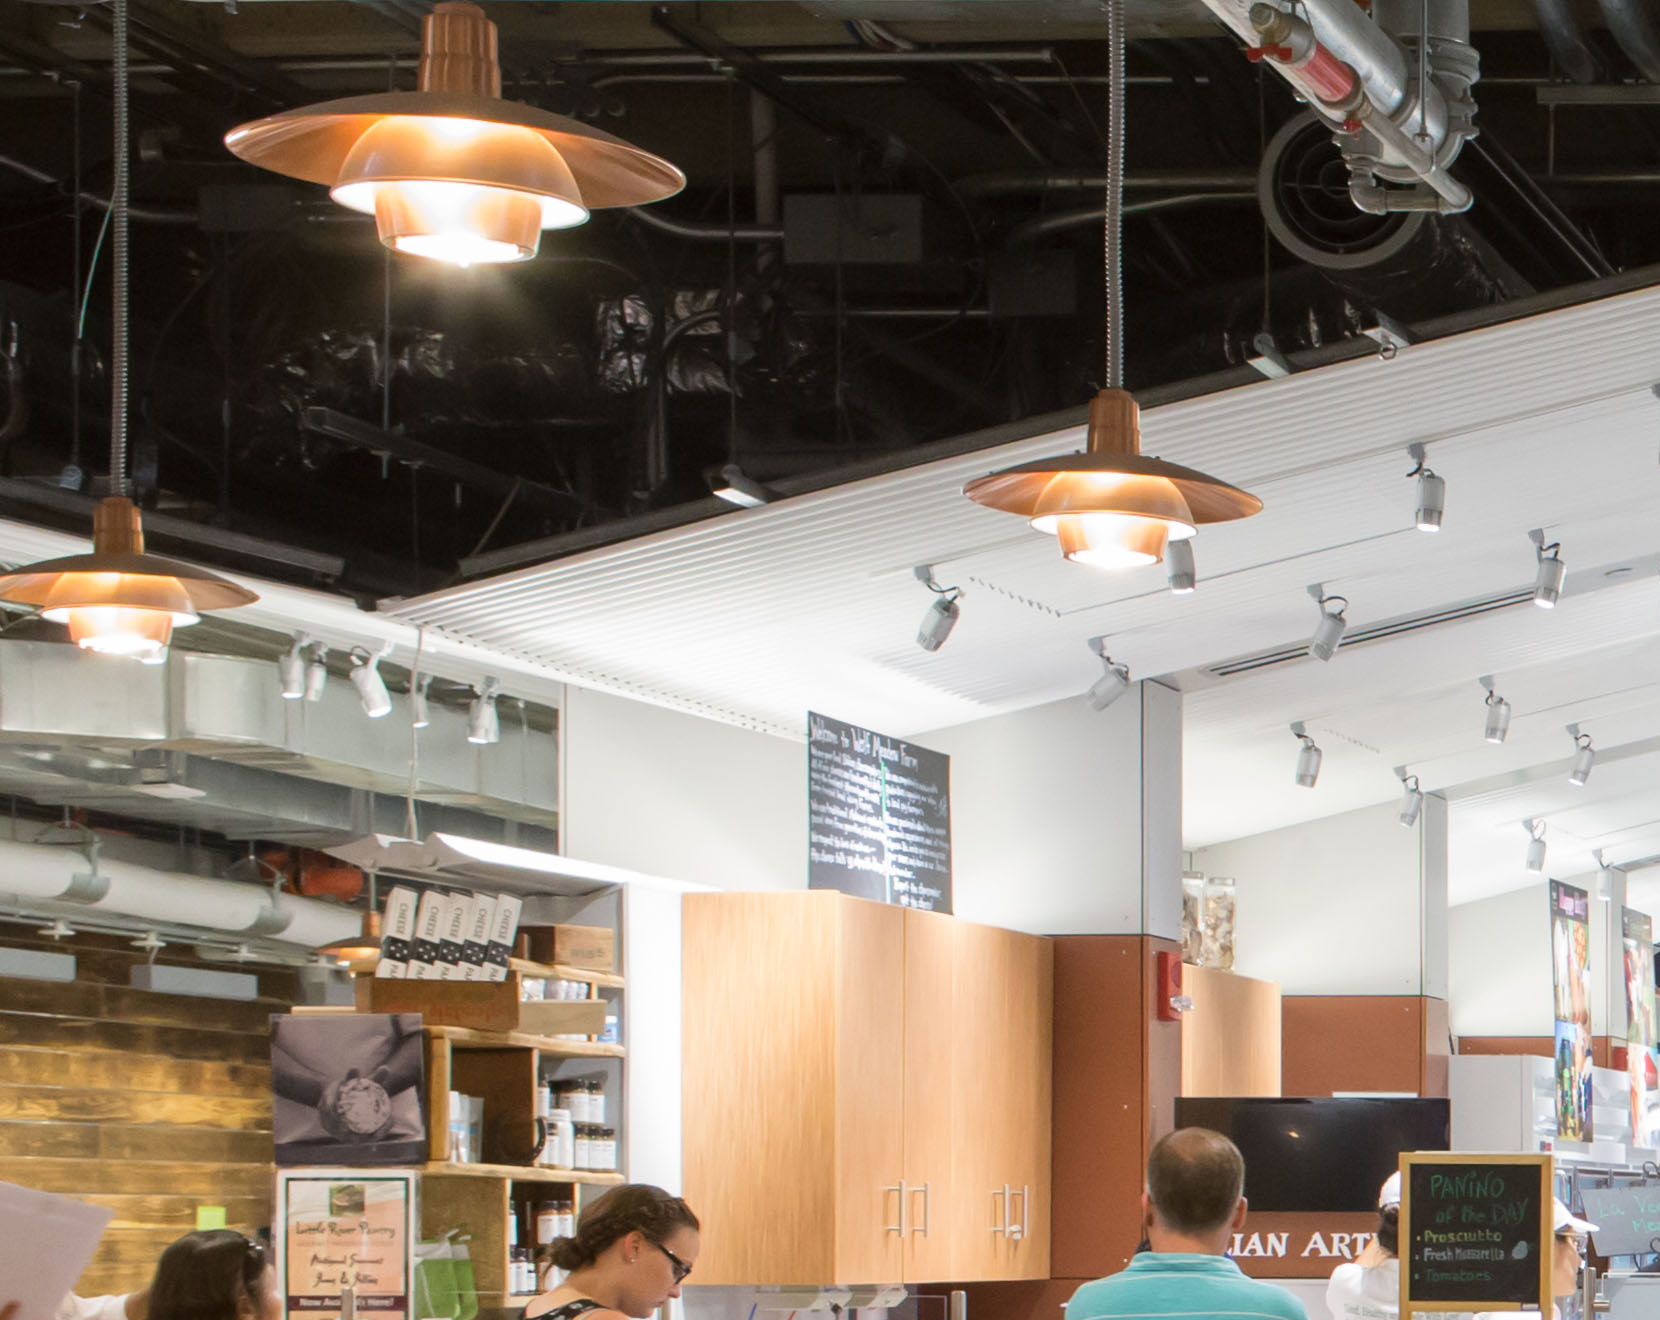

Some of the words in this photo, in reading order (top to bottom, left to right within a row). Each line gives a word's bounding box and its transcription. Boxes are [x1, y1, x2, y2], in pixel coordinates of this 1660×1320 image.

[396, 903, 409, 936] CHEESE
[426, 906, 439, 938] CHEESE
[450, 907, 463, 938] CHEESE
[474, 908, 487, 939] CHEESE
[498, 909, 512, 940] CHEESE
[1435, 1204, 1455, 1223] of
[1461, 1204, 1485, 1223] the
[1492, 1198, 1528, 1225] DAY
[1230, 1232, 1290, 1258] IAN
[1300, 1232, 1379, 1259] ART
[1424, 1229, 1502, 1244] Prosciutto
[1423, 1248, 1452, 1262] Fresh
